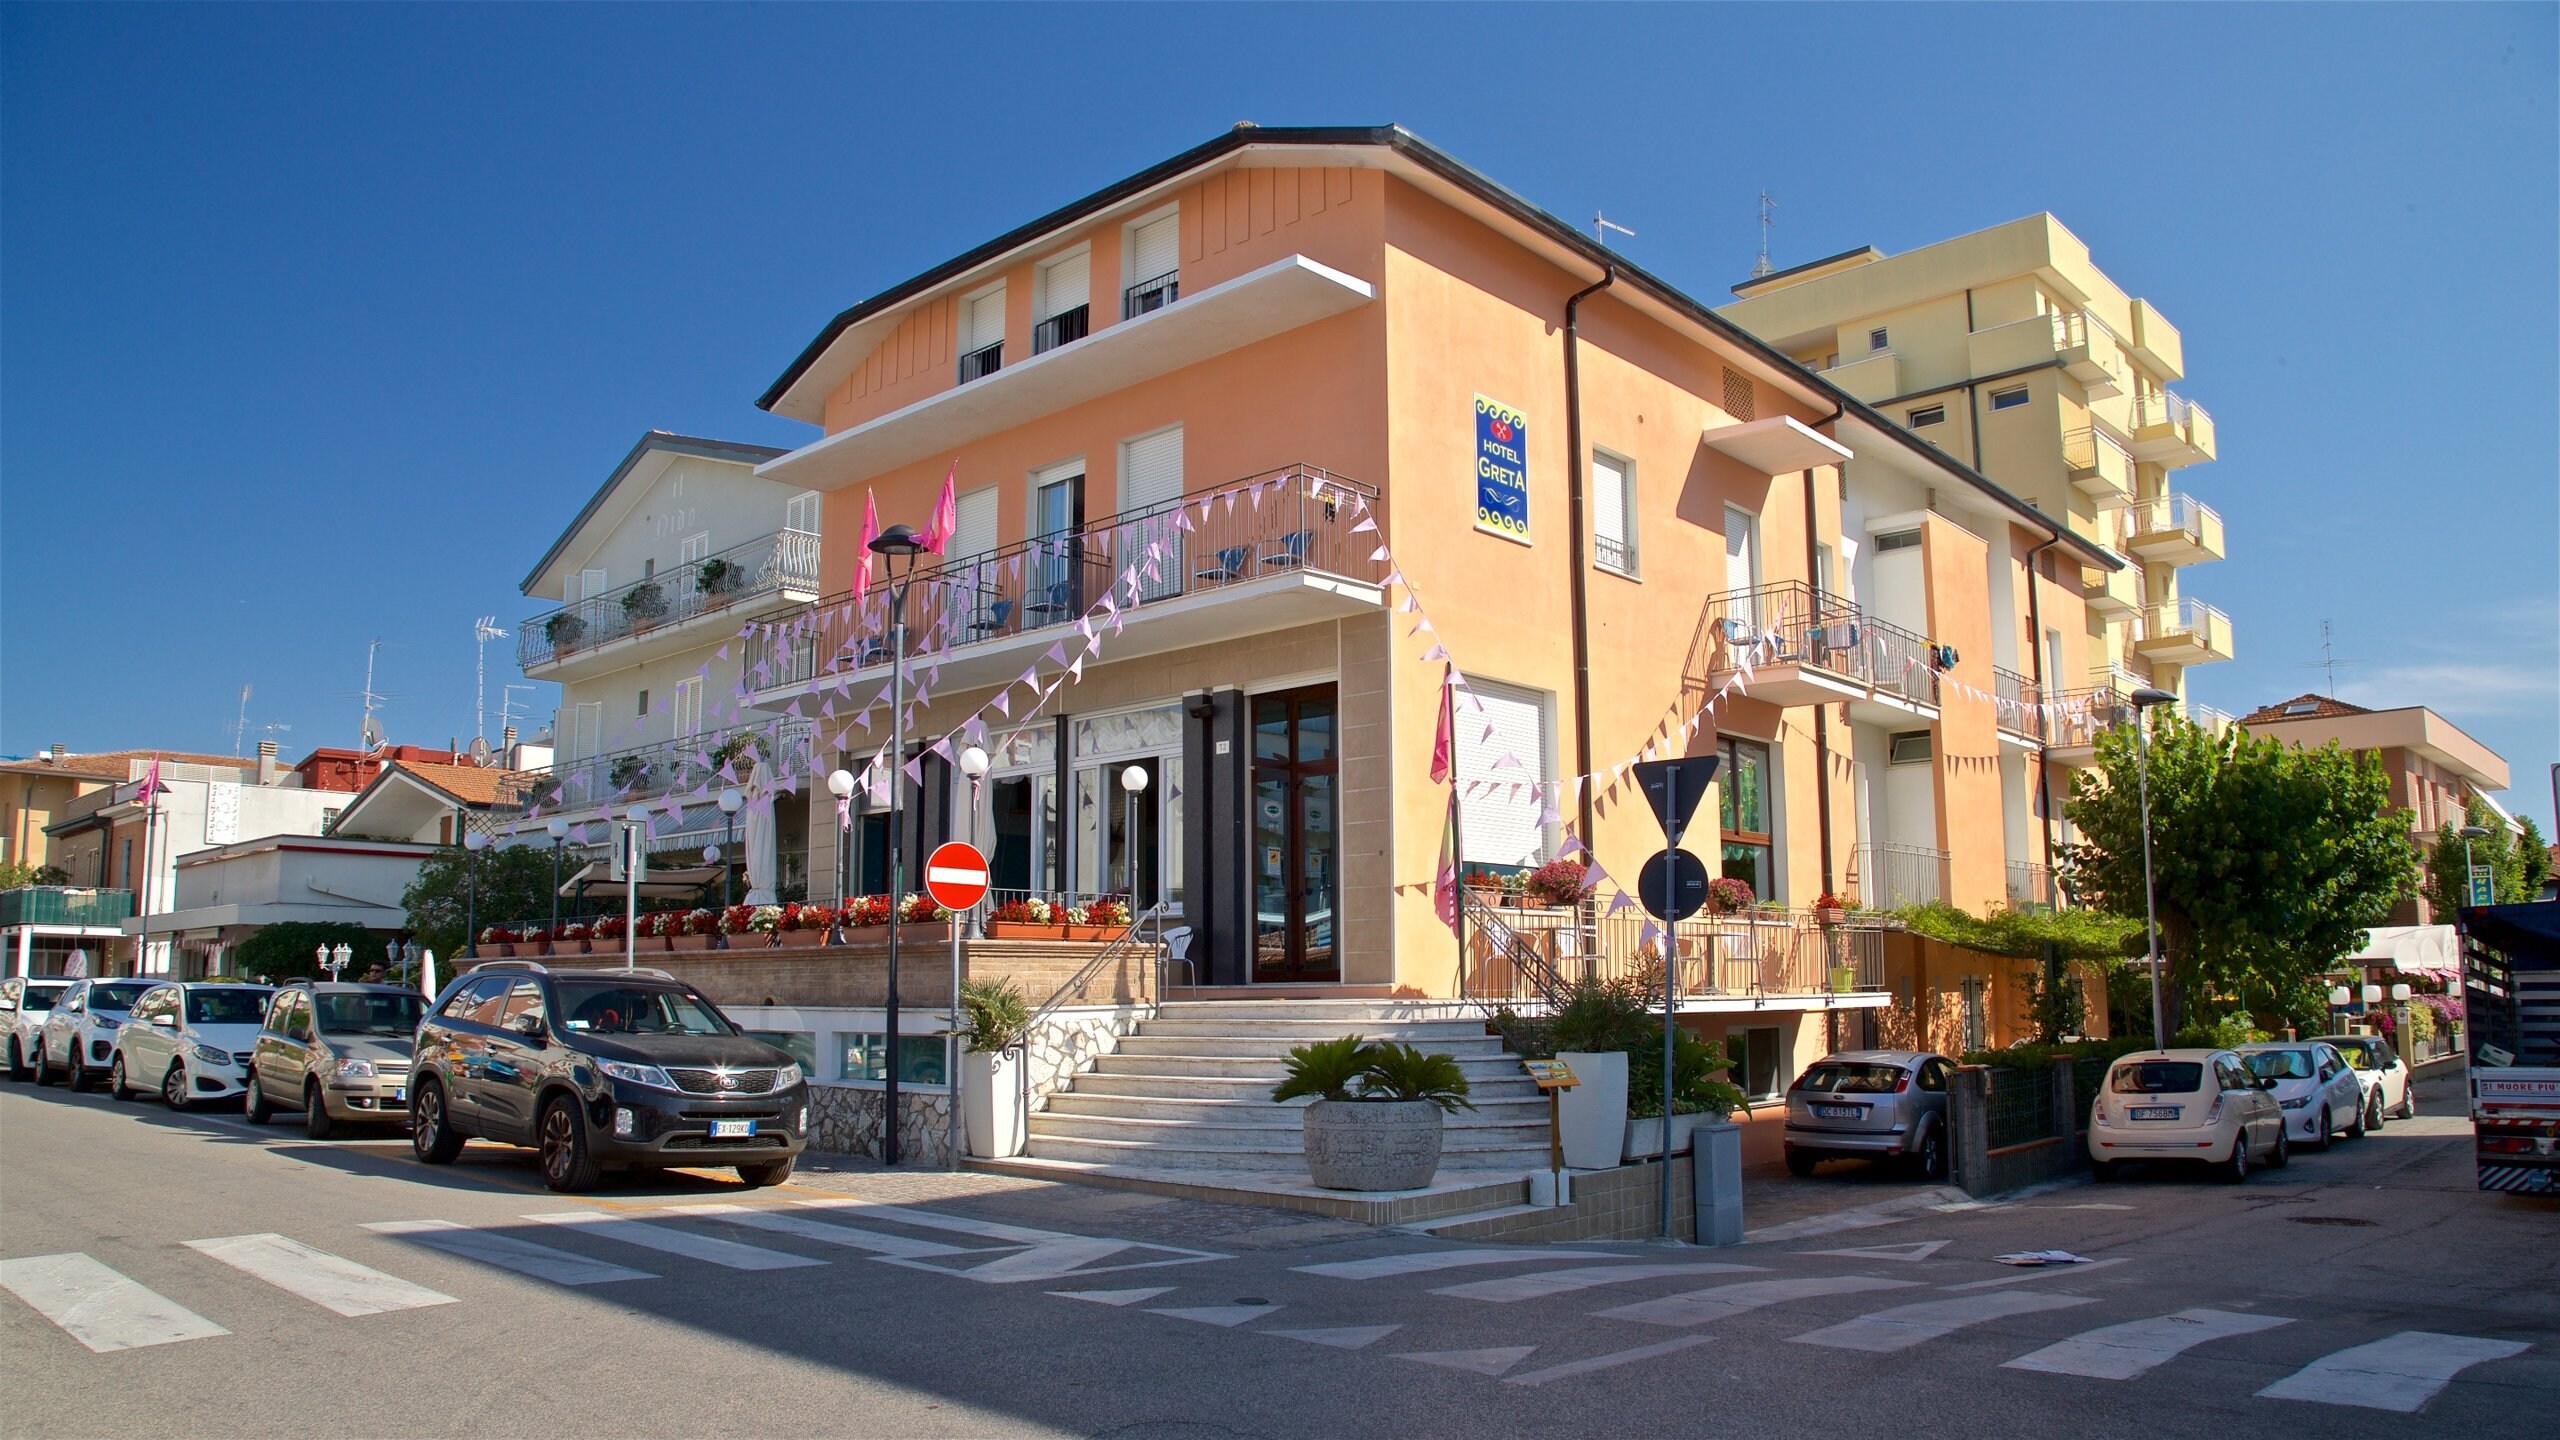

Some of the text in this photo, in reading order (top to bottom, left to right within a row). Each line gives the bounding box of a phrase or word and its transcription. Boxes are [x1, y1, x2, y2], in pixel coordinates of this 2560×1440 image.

[1483, 438, 1521, 465] HOTEL
[1478, 456, 1526, 492] GRETA
[2497, 1083, 2532, 1091] MUORE
